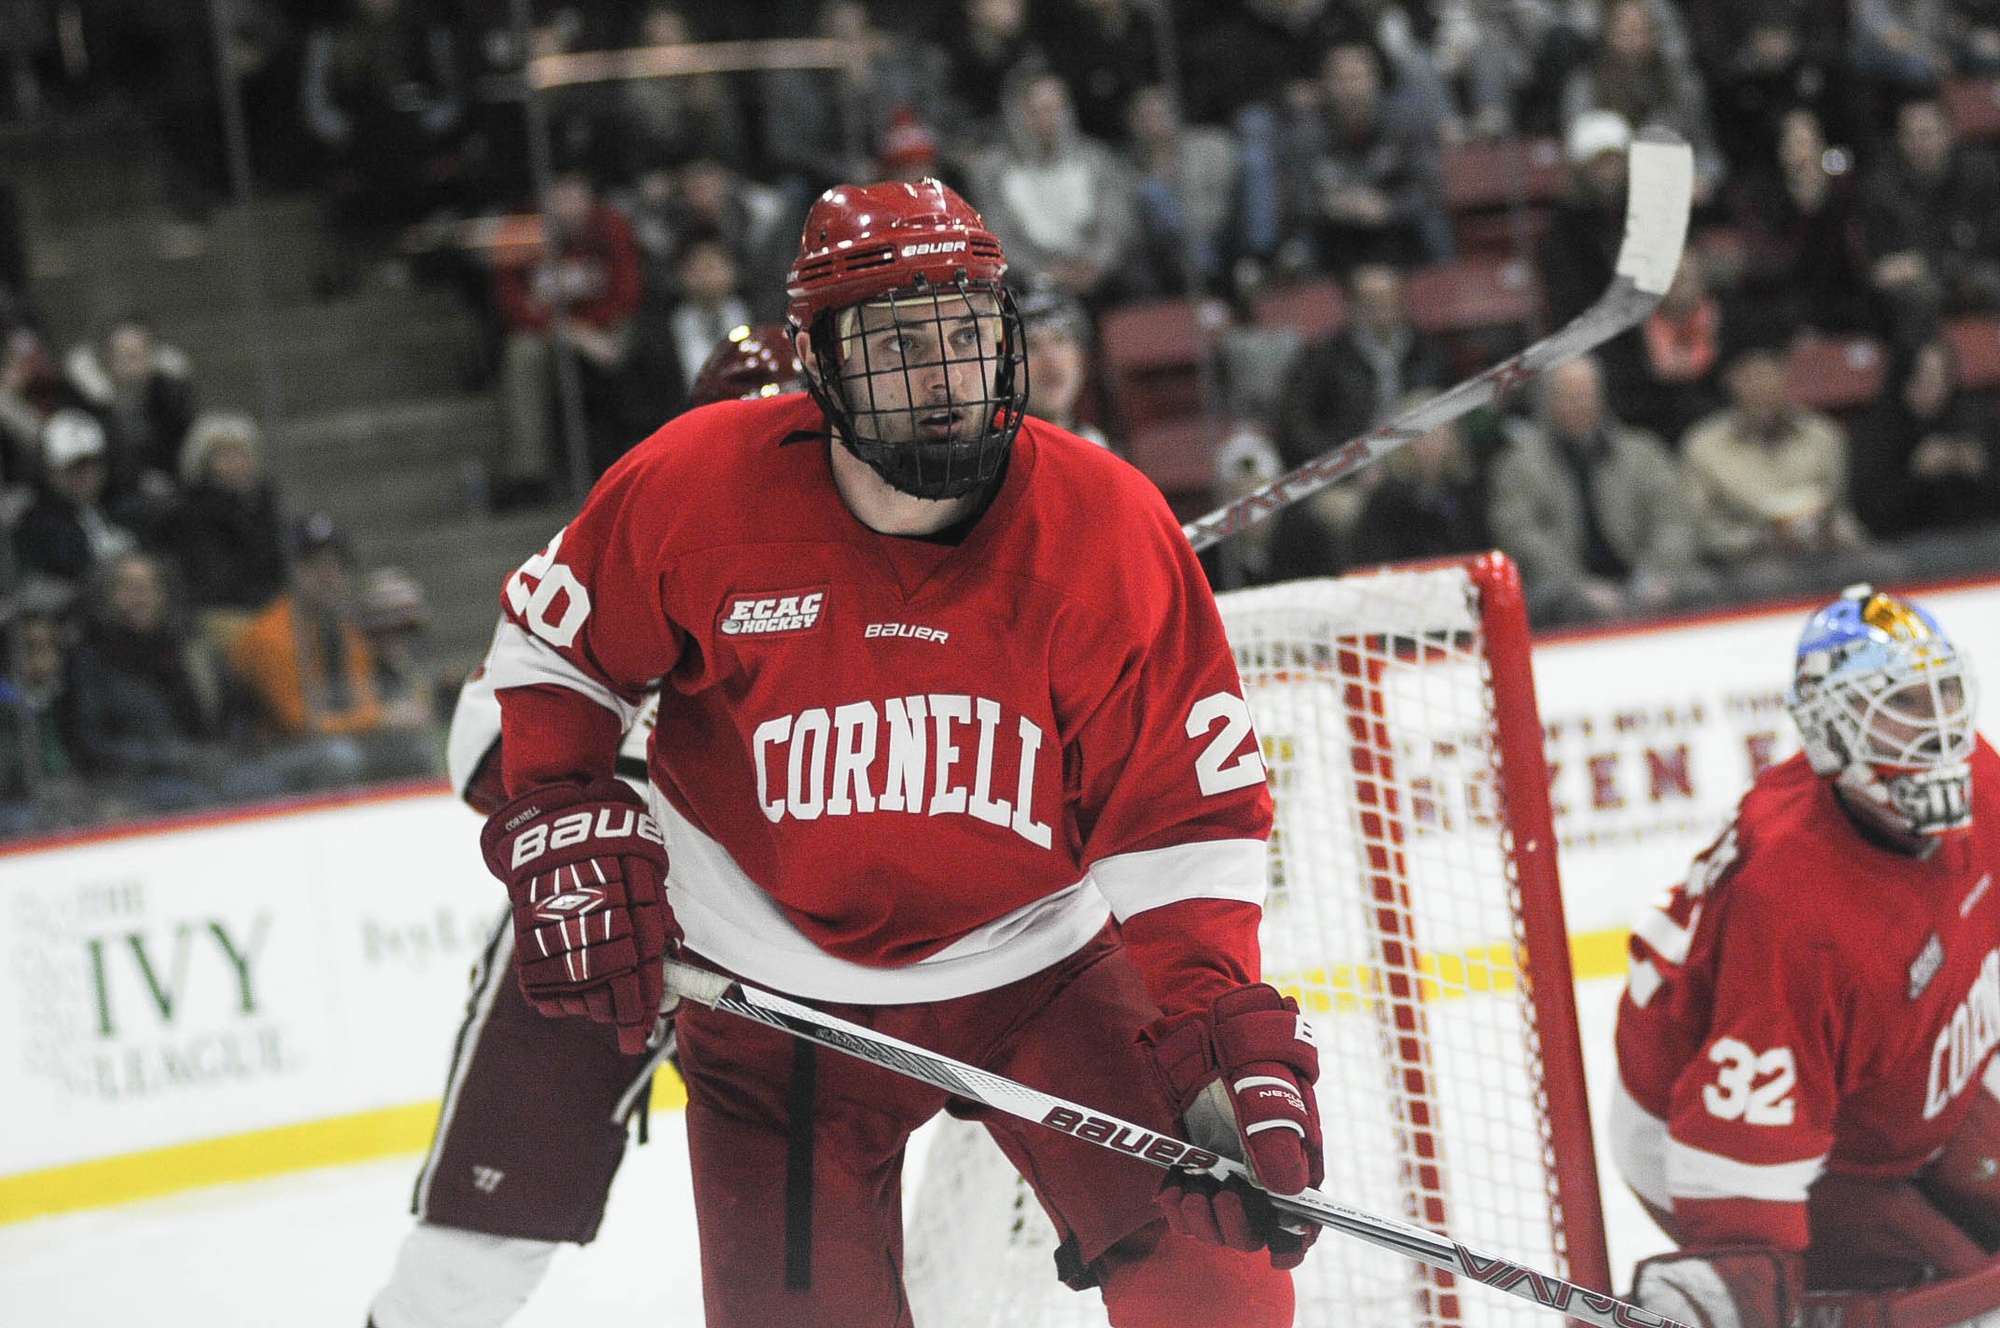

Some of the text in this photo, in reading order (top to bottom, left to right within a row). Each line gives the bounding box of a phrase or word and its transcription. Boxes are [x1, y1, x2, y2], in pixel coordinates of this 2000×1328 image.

[901, 241, 966, 257] BAUER
[506, 525, 591, 648] 20
[730, 592, 823, 620] ECAC
[740, 613, 817, 634] HOCKEY
[864, 622, 949, 645] BAUER
[1185, 676, 1268, 797] 2
[752, 693, 1052, 850] CORNELL
[505, 806, 542, 832] CORNELL
[512, 807, 665, 871] BAUE
[84, 908, 275, 1039] IVY
[1702, 1037, 1797, 1126] 32
[1041, 1105, 1220, 1169] BAUER
